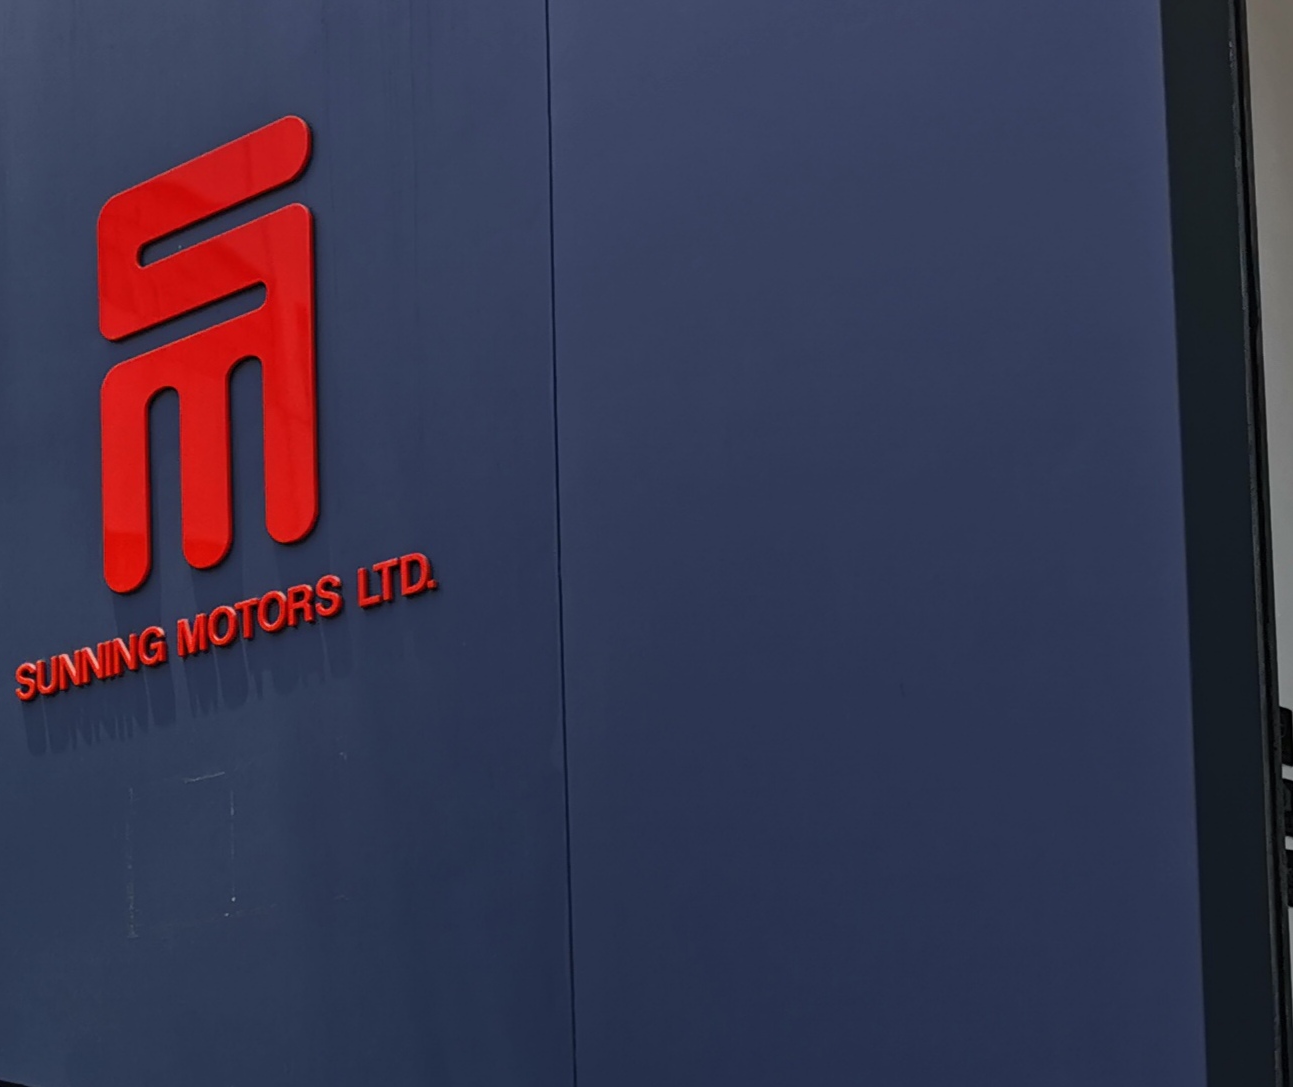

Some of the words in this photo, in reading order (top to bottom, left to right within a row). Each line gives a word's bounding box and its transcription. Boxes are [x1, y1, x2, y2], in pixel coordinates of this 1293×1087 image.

[15, 626, 167, 701] SUNNING
[177, 575, 343, 657] MOTORS
[357, 552, 437, 608] LTD.
